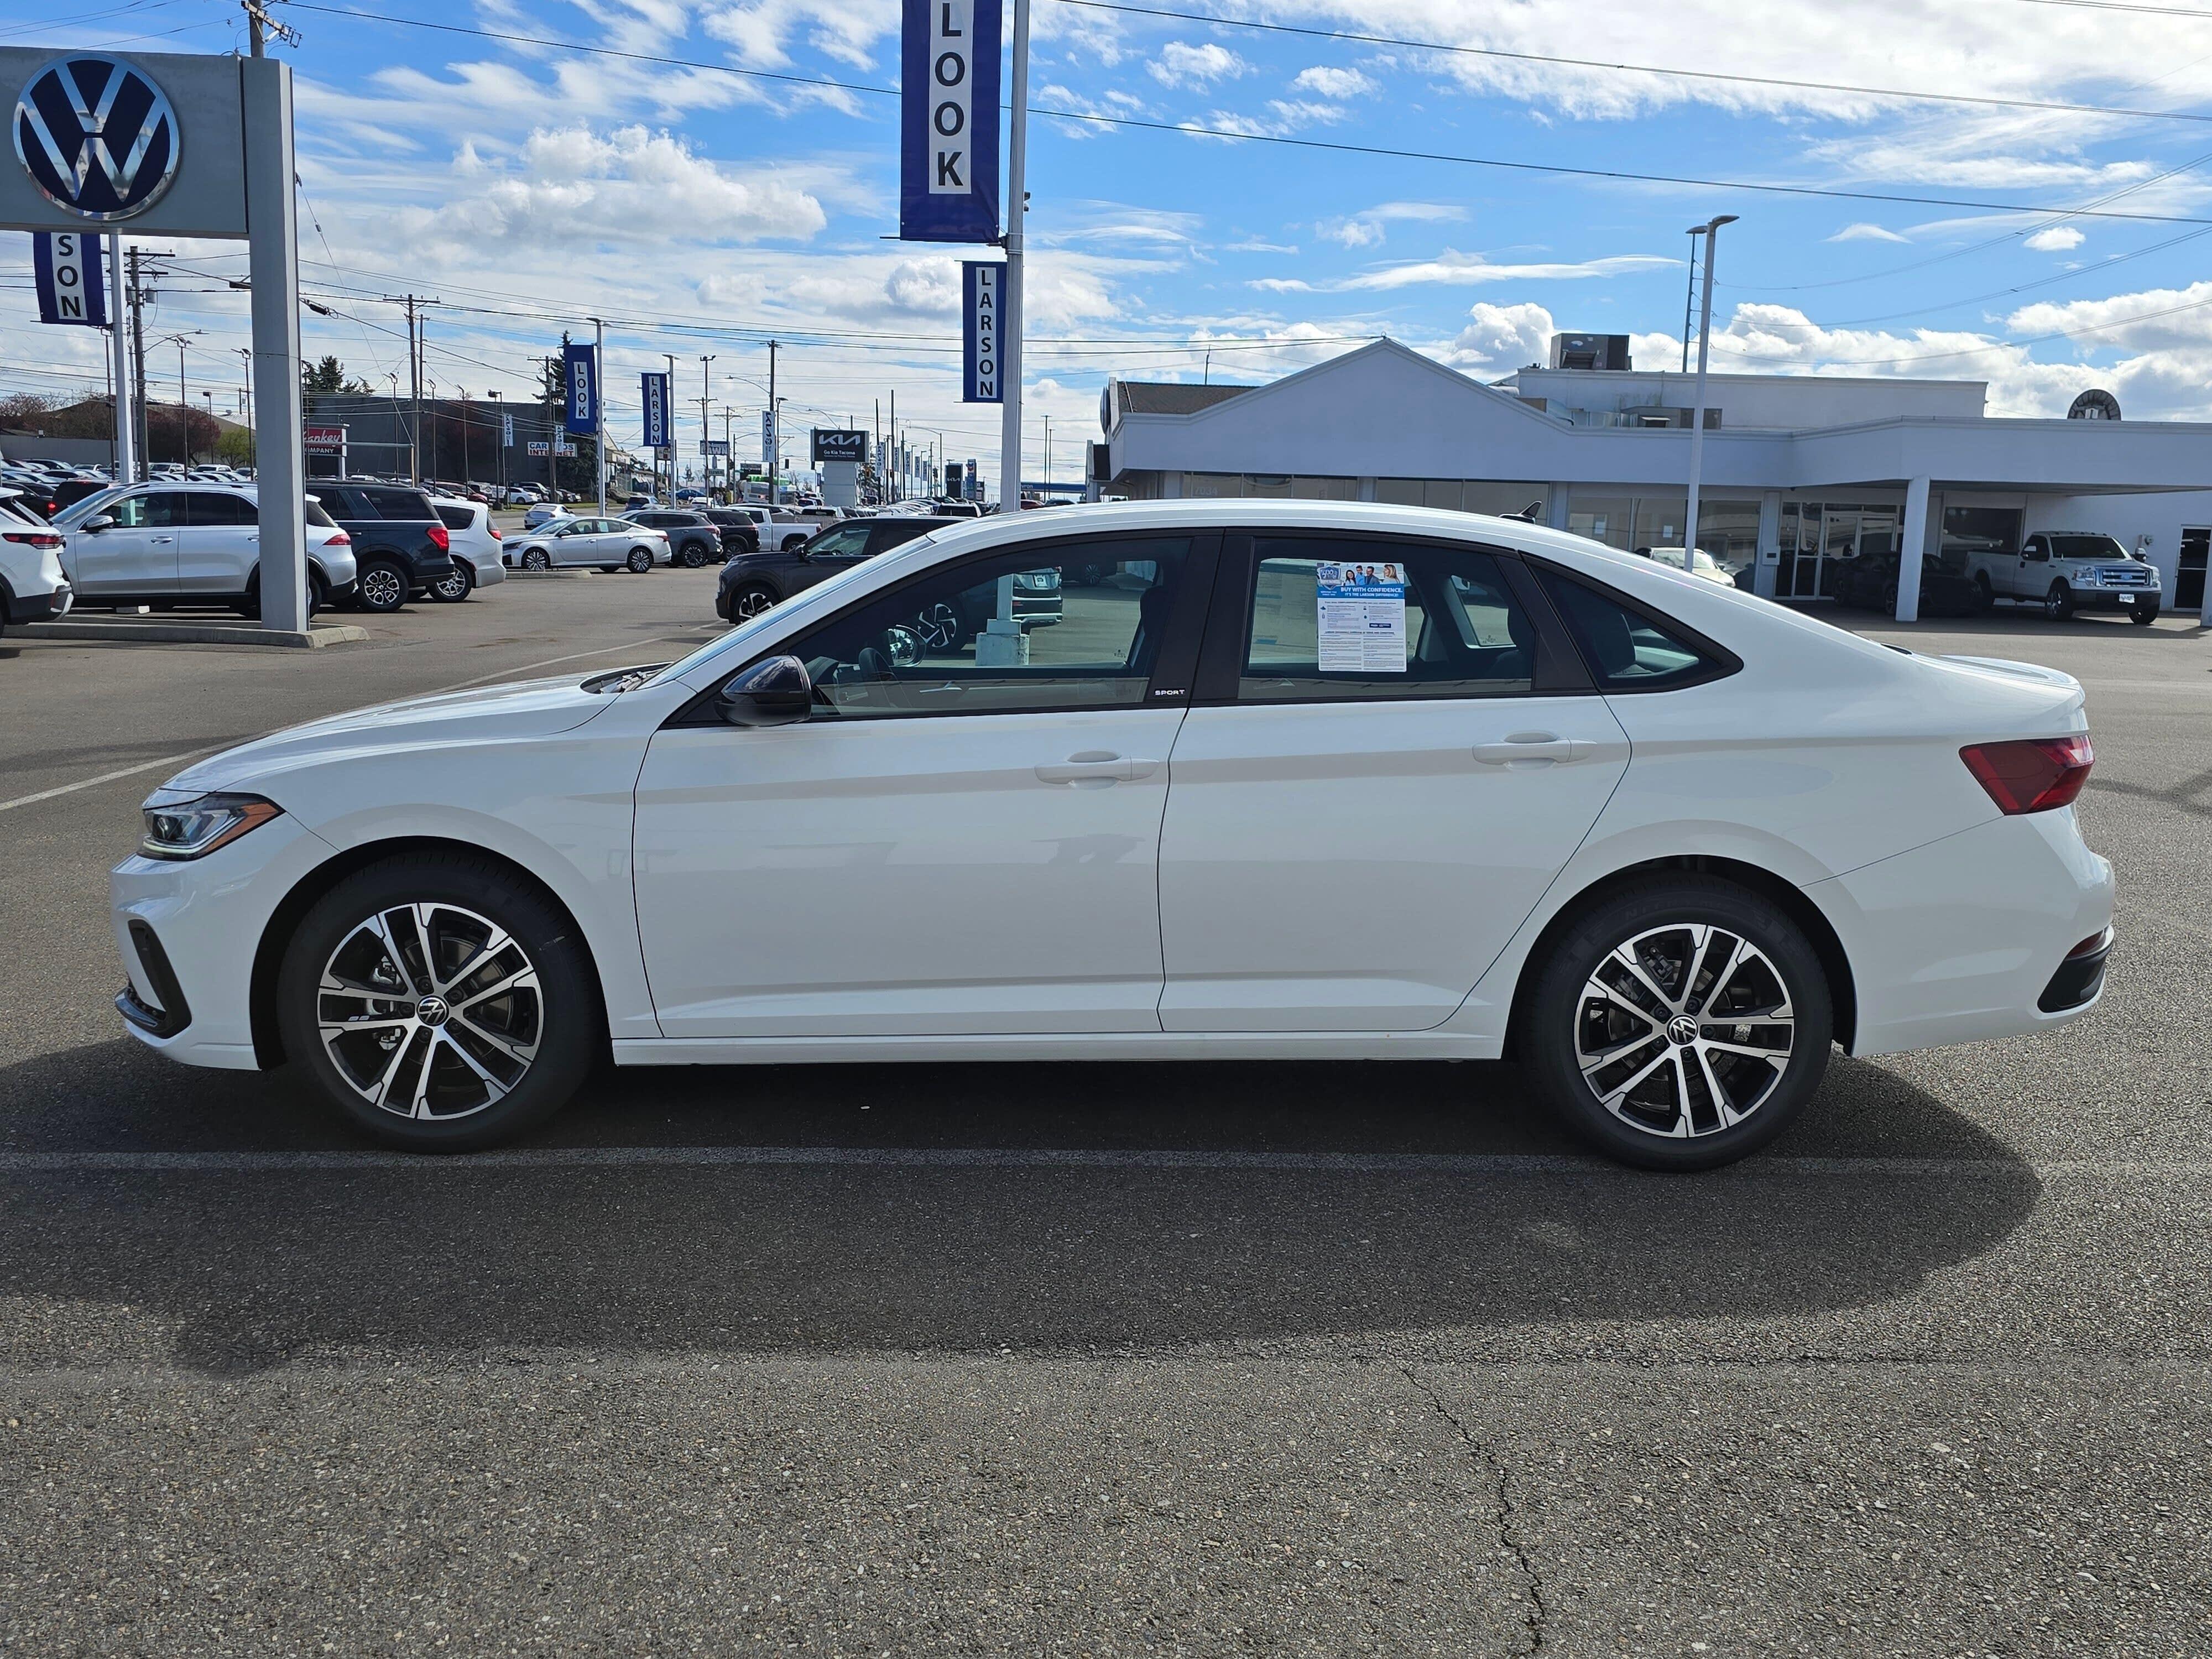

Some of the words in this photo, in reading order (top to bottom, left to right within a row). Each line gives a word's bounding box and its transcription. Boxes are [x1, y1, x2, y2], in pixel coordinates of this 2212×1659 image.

[934, 3, 965, 186] LOOK
[14, 54, 180, 218] VW
[58, 235, 81, 317] SON
[979, 270, 993, 397] LARSON
[577, 364, 586, 417] LOOK
[651, 378, 660, 444] LARSON
[819, 434, 860, 446] KIA
